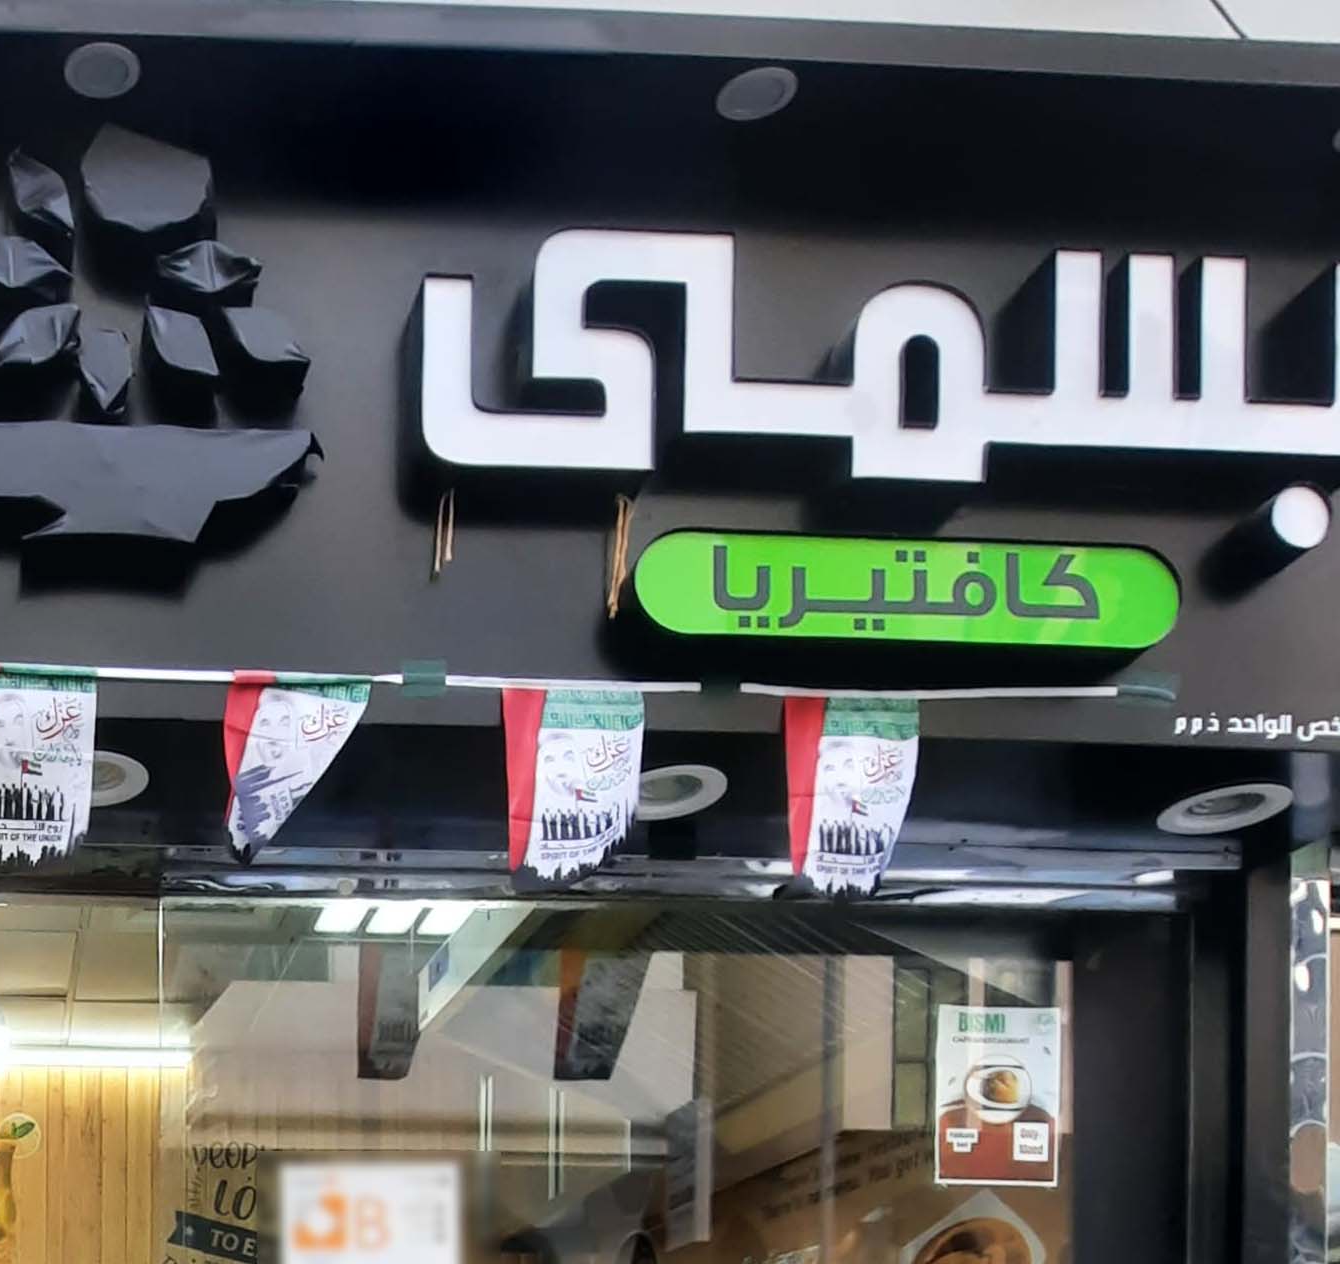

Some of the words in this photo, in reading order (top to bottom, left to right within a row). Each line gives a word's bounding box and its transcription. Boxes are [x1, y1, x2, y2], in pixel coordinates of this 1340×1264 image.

[711, 544, 1102, 632] كافتيريا
[1226, 713, 1293, 740] الواحد
[958, 1012, 1005, 1034] BISMI
[211, 1229, 239, 1251] TO
[242, 1238, 259, 1258] E
